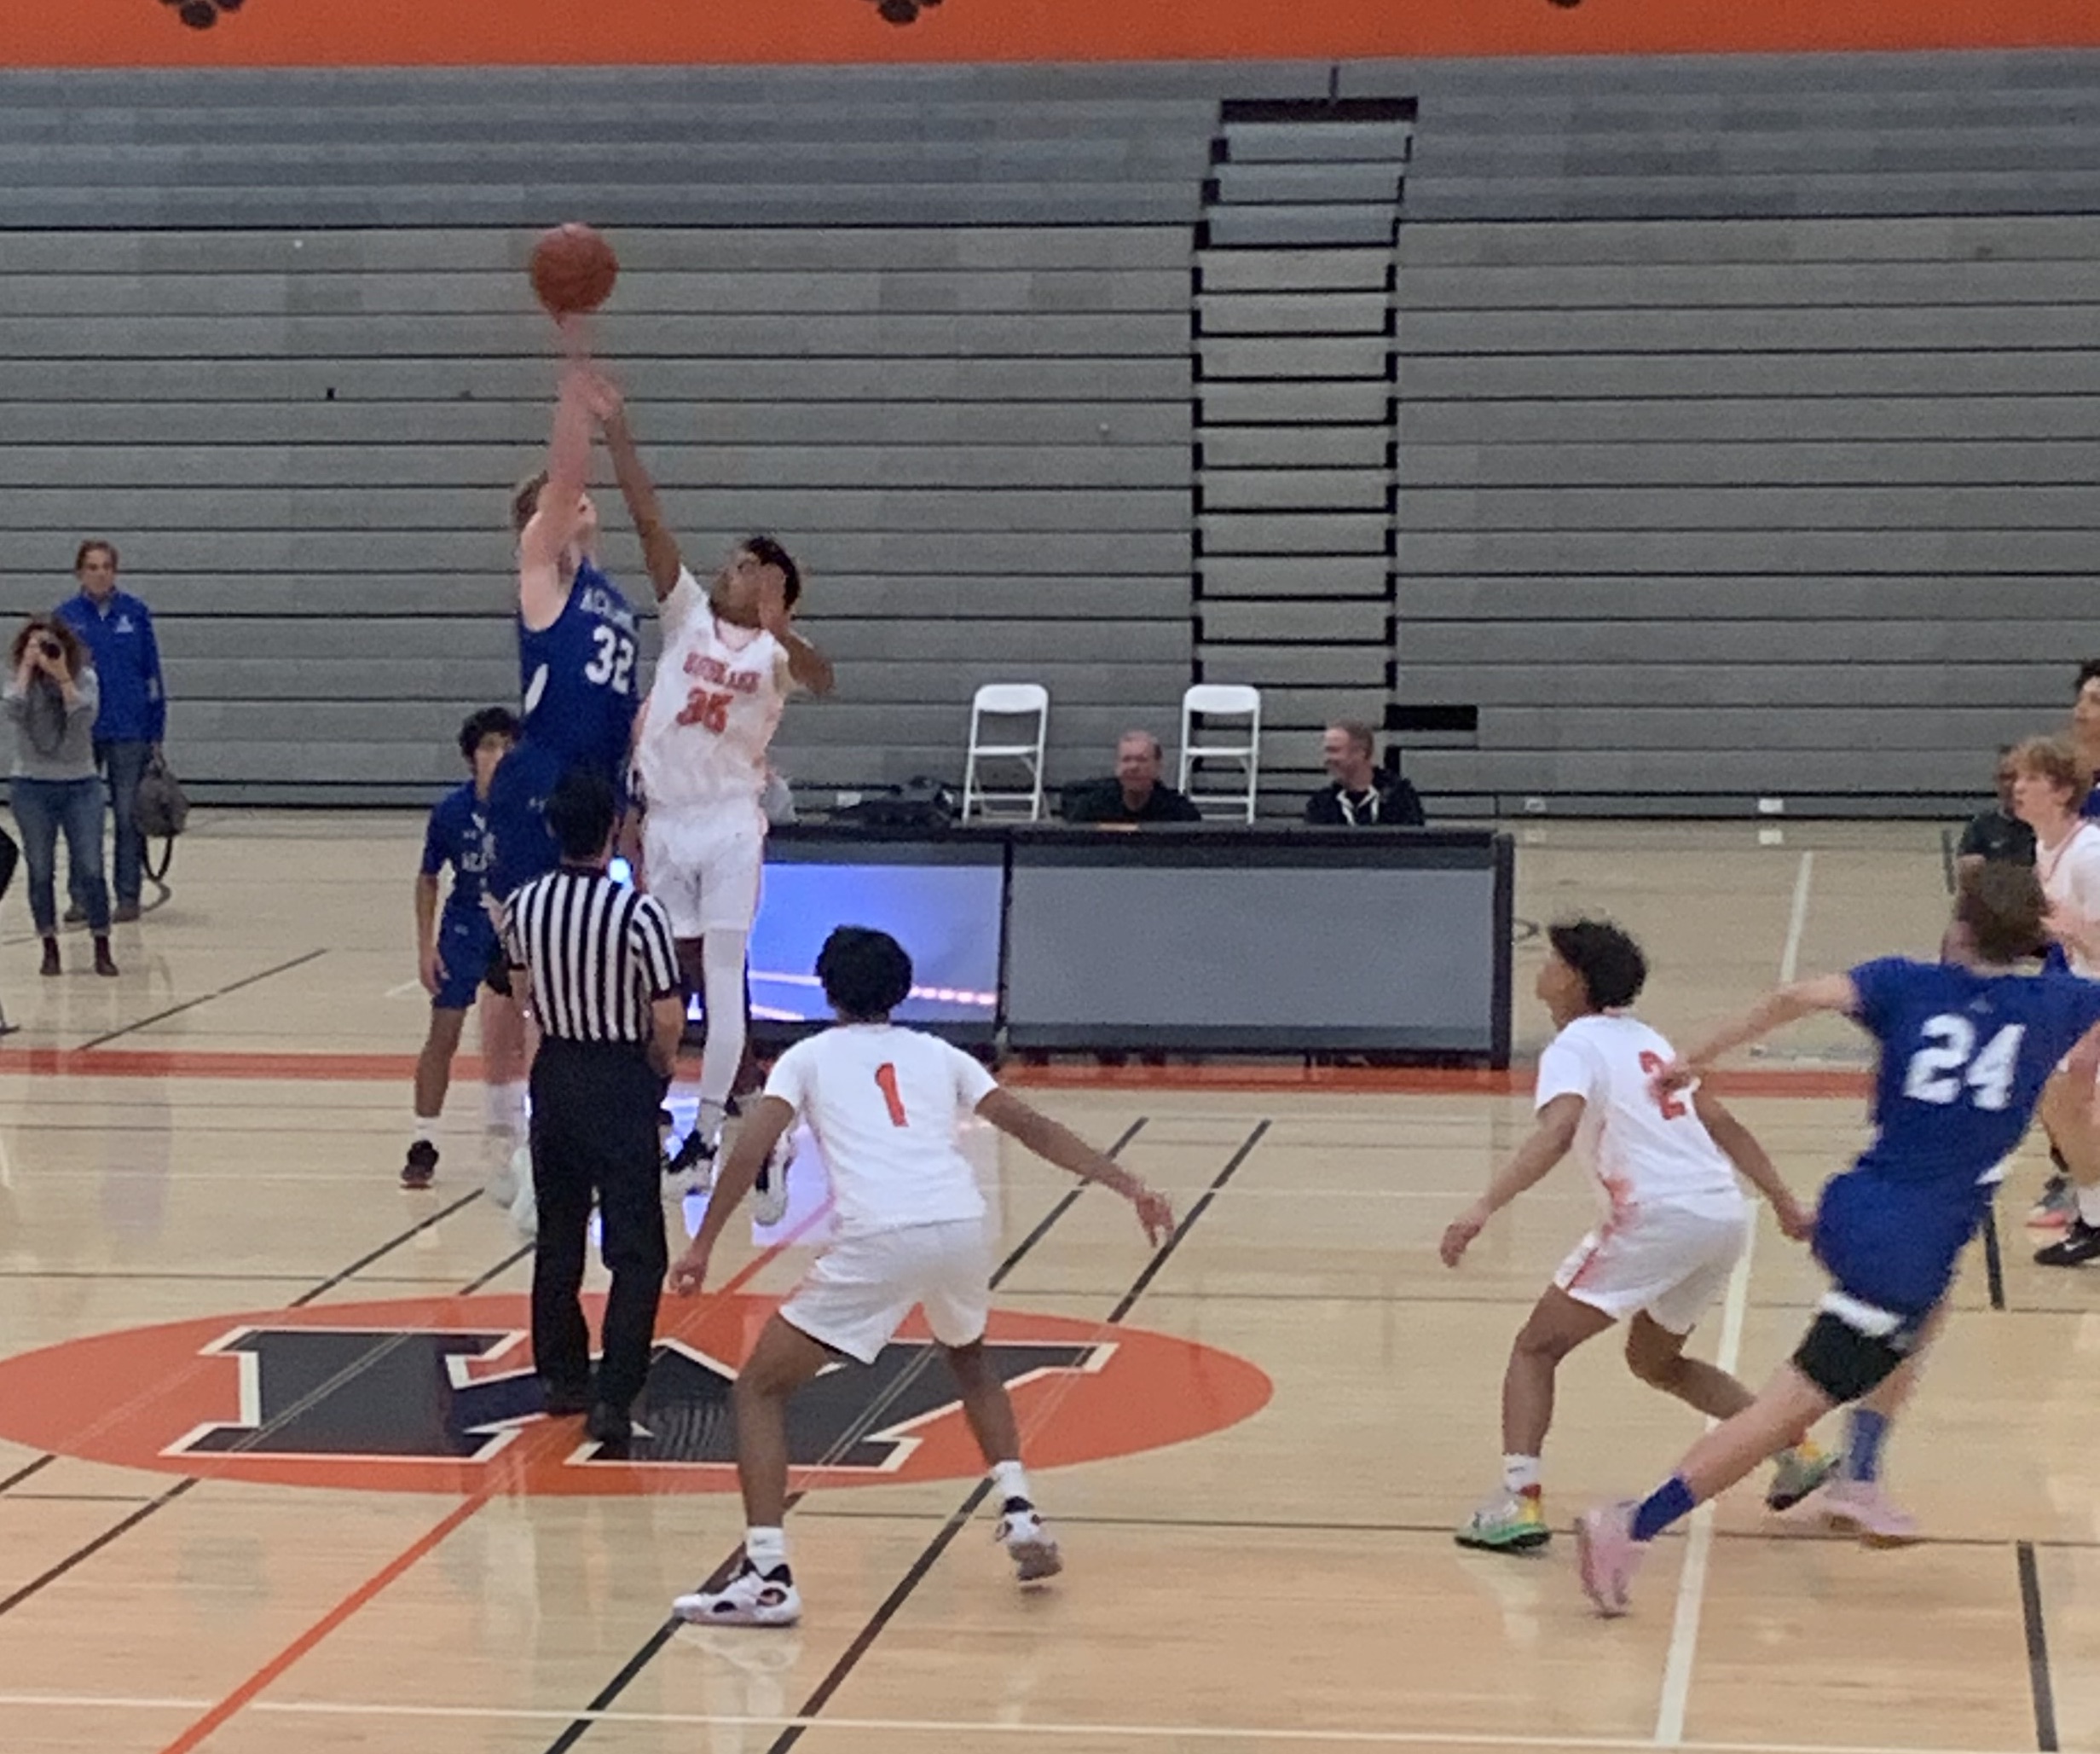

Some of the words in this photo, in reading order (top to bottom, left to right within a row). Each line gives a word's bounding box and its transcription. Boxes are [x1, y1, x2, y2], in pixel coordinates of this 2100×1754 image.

[585, 625, 634, 694] 32
[874, 1062, 910, 1127] 1
[1902, 1013, 2027, 1112] 24
